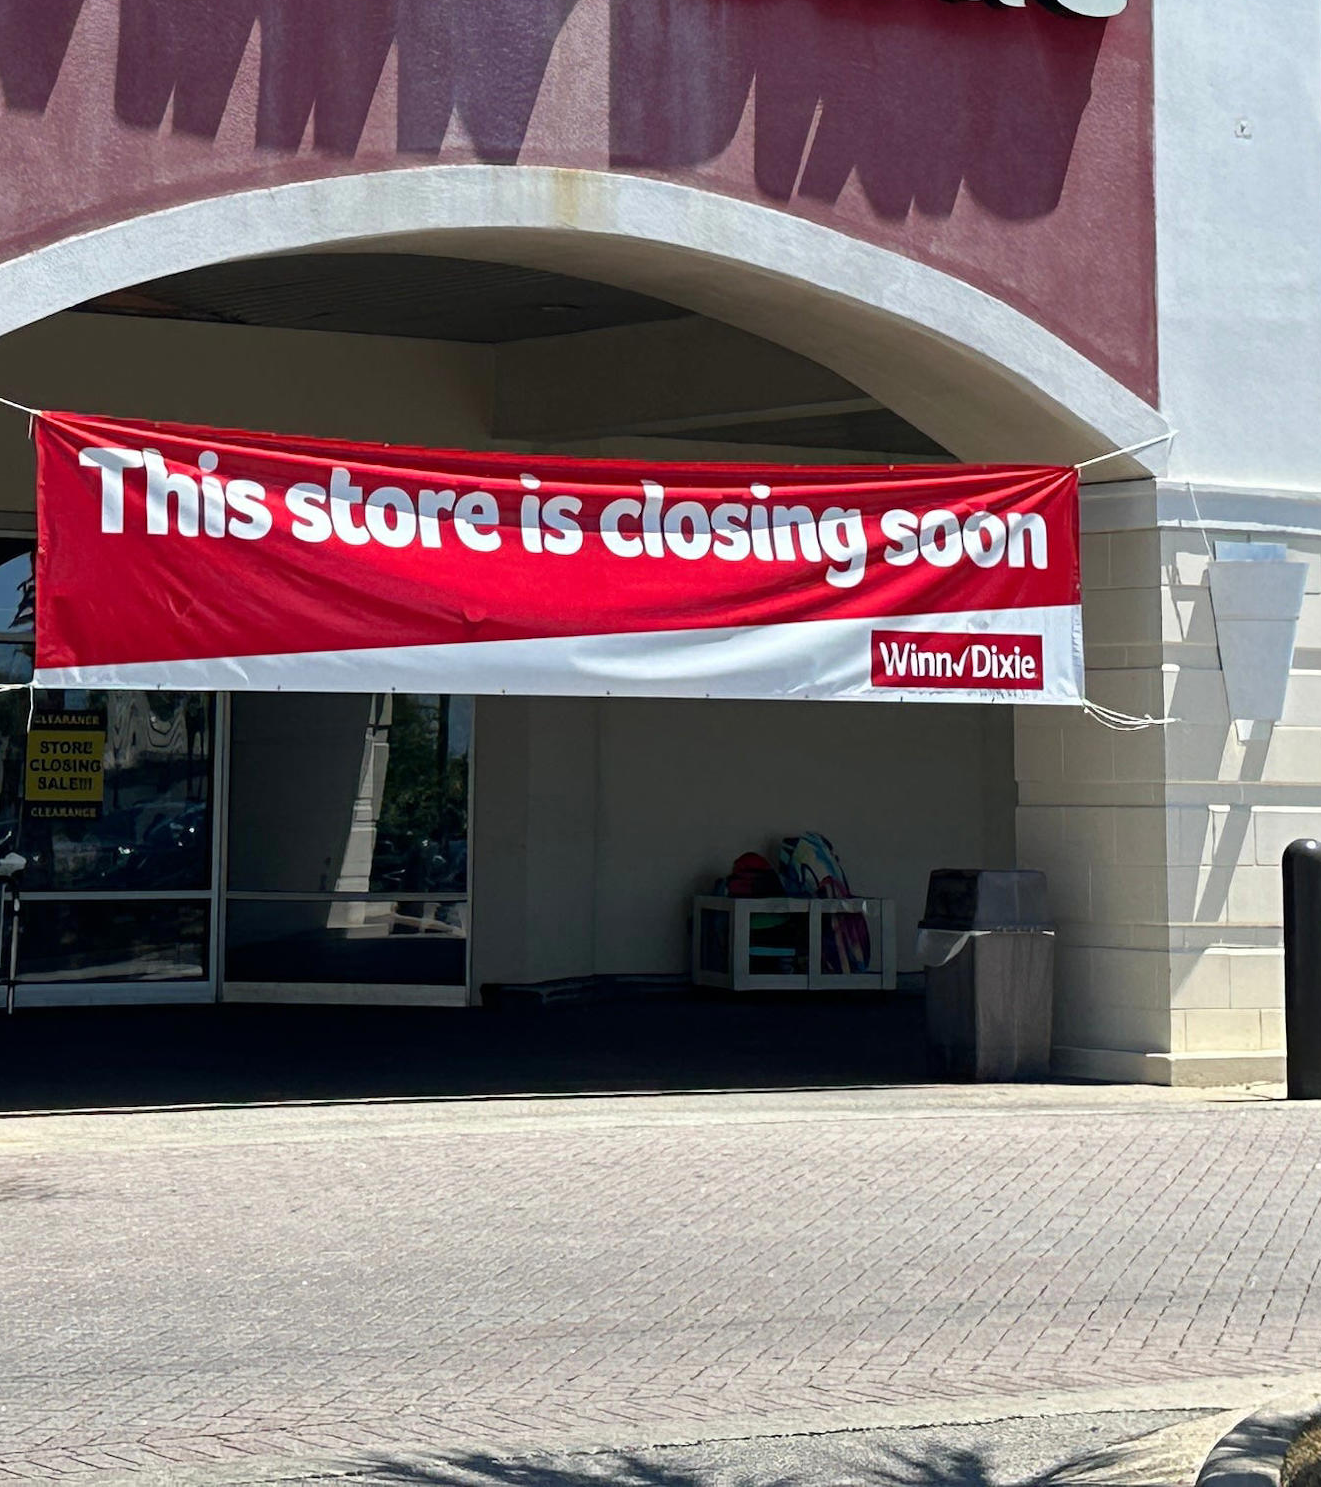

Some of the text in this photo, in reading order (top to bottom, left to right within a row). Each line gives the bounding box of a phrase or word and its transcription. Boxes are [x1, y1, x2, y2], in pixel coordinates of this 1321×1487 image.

[79, 447, 1049, 589] This store is closing soon
[879, 642, 1037, 680] Winn Dixie
[40, 741, 94, 755] STORE
[30, 759, 101, 773] CLOSING
